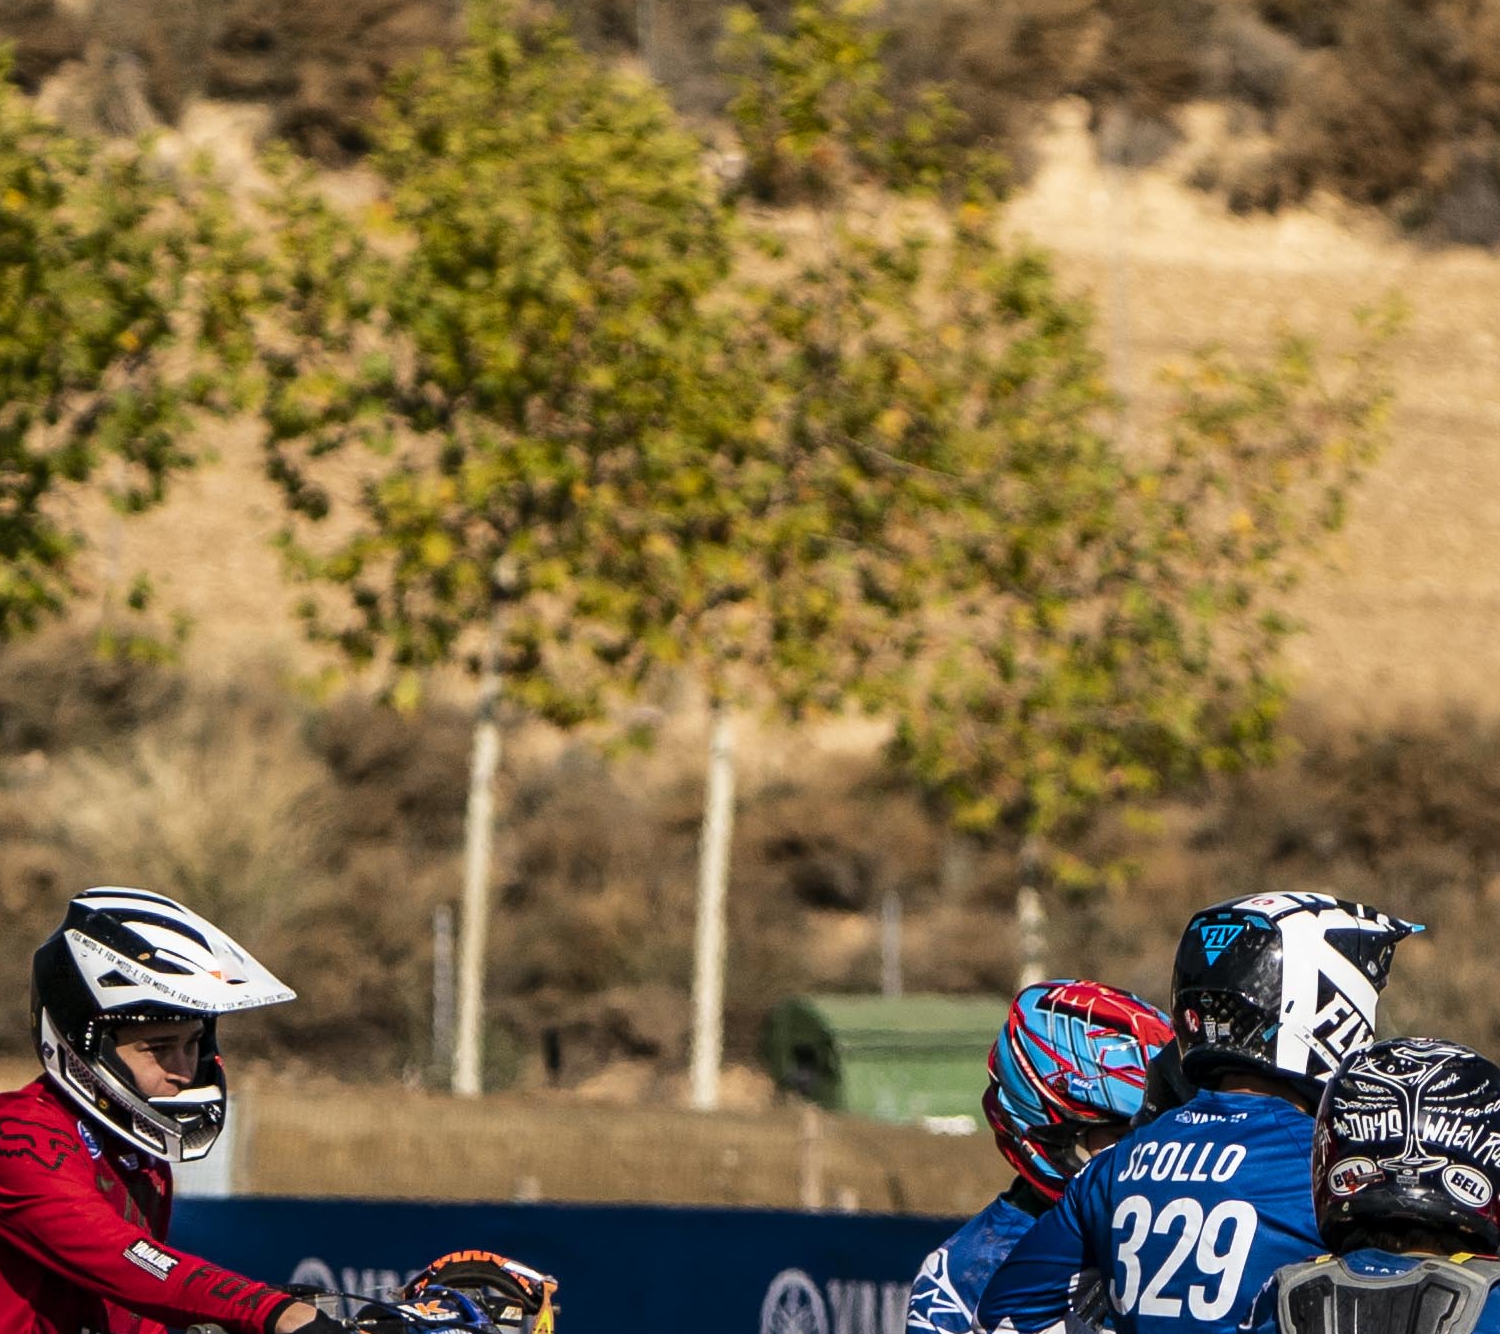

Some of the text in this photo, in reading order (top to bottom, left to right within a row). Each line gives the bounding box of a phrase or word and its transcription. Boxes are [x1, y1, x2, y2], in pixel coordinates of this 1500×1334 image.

[1203, 928, 1241, 947] FLY
[71, 932, 82, 943] FOX
[82, 936, 104, 955] MOTO-X
[104, 951, 116, 964] FOX
[115, 958, 140, 981] MOTO-X
[140, 973, 153, 986] FOX
[152, 981, 177, 998] MOTO-X
[178, 992, 190, 1005] FOX
[1312, 993, 1374, 1059] FLY
[1349, 1109, 1404, 1142] DAYS
[1422, 1115, 1485, 1159] WHEN
[1118, 1141, 1247, 1183] SCOLLO
[1450, 1172, 1484, 1200] BELL
[132, 1240, 179, 1273] YAMALUBE
[1109, 1194, 1258, 1322] 329
[184, 1265, 271, 1311] FOX
